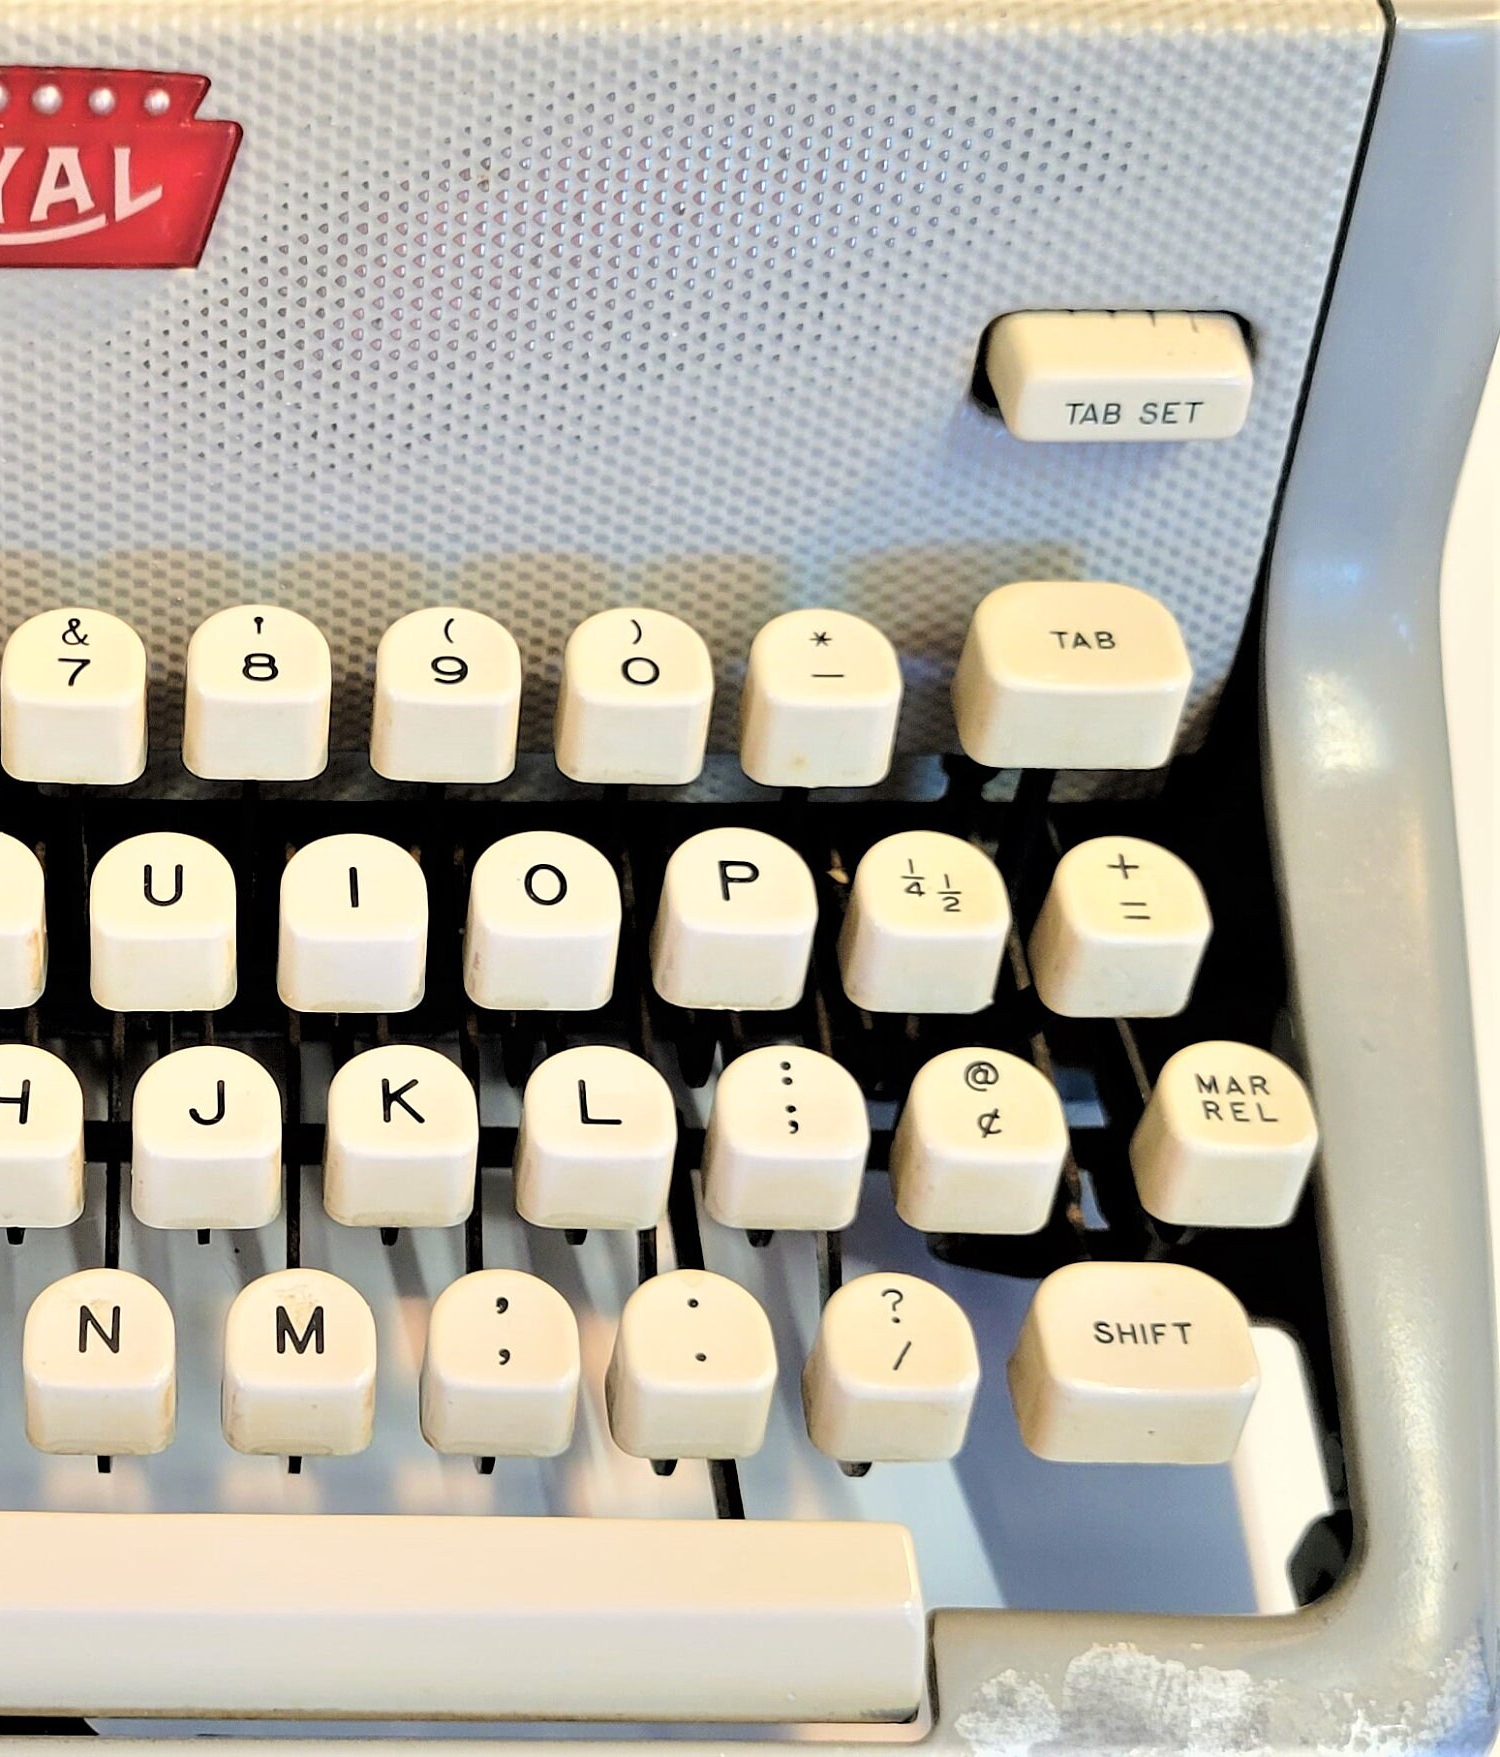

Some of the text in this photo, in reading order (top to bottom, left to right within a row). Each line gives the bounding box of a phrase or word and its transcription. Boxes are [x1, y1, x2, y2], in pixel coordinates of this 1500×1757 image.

[1065, 401, 1204, 425] TAB SET
[61, 617, 90, 646] &
[443, 618, 455, 644] (
[631, 619, 643, 645] )
[1050, 631, 1116, 650] TAB
[57, 657, 91, 687] 7
[241, 652, 279, 682] 8
[430, 655, 469, 685] 9
[718, 860, 760, 902] P
[1108, 854, 1140, 880] +
[143, 863, 184, 907] U
[348, 866, 360, 908] I
[523, 863, 568, 906] O
[965, 1061, 999, 1092] @
[1196, 1074, 1270, 1095] MAR
[188, 1079, 226, 1126] J
[381, 1078, 426, 1124] K
[578, 1079, 623, 1126] L
[1202, 1100, 1278, 1123] REL
[881, 1288, 904, 1324] ?
[78, 1304, 121, 1354] N
[275, 1305, 325, 1355] M
[1094, 1321, 1192, 1345] SHIFT
[892, 1341, 912, 1371] /
